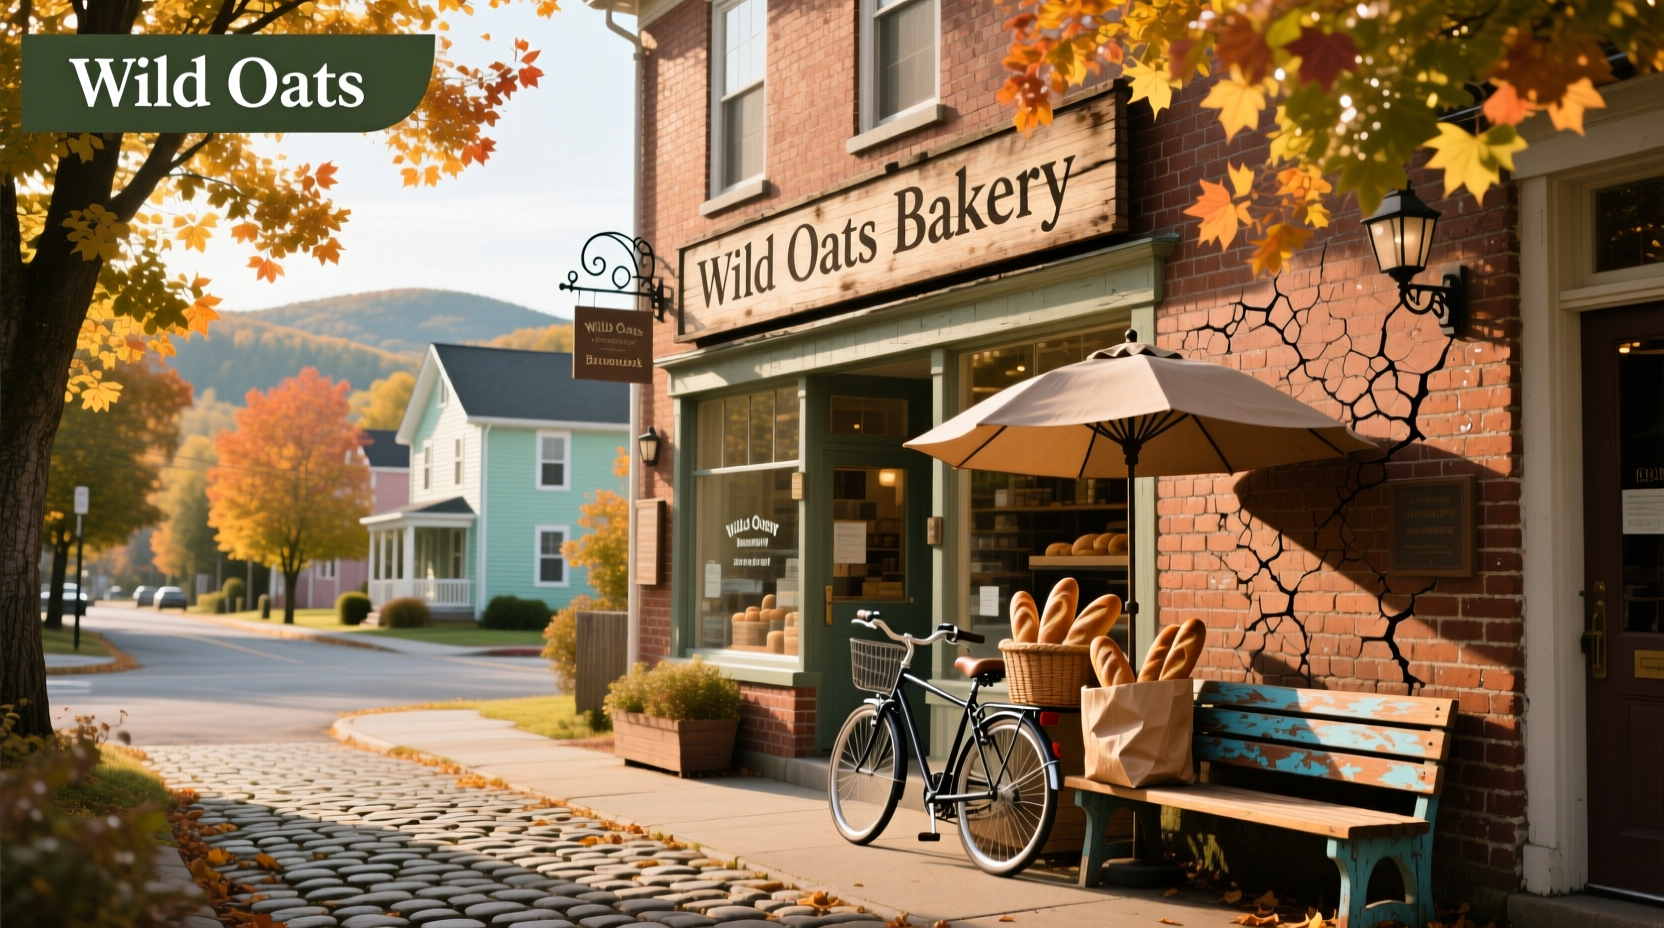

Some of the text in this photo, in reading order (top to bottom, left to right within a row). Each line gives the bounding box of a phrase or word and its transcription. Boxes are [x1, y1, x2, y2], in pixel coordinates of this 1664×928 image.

[696, 154, 1077, 309] Wild Oats Bakery
